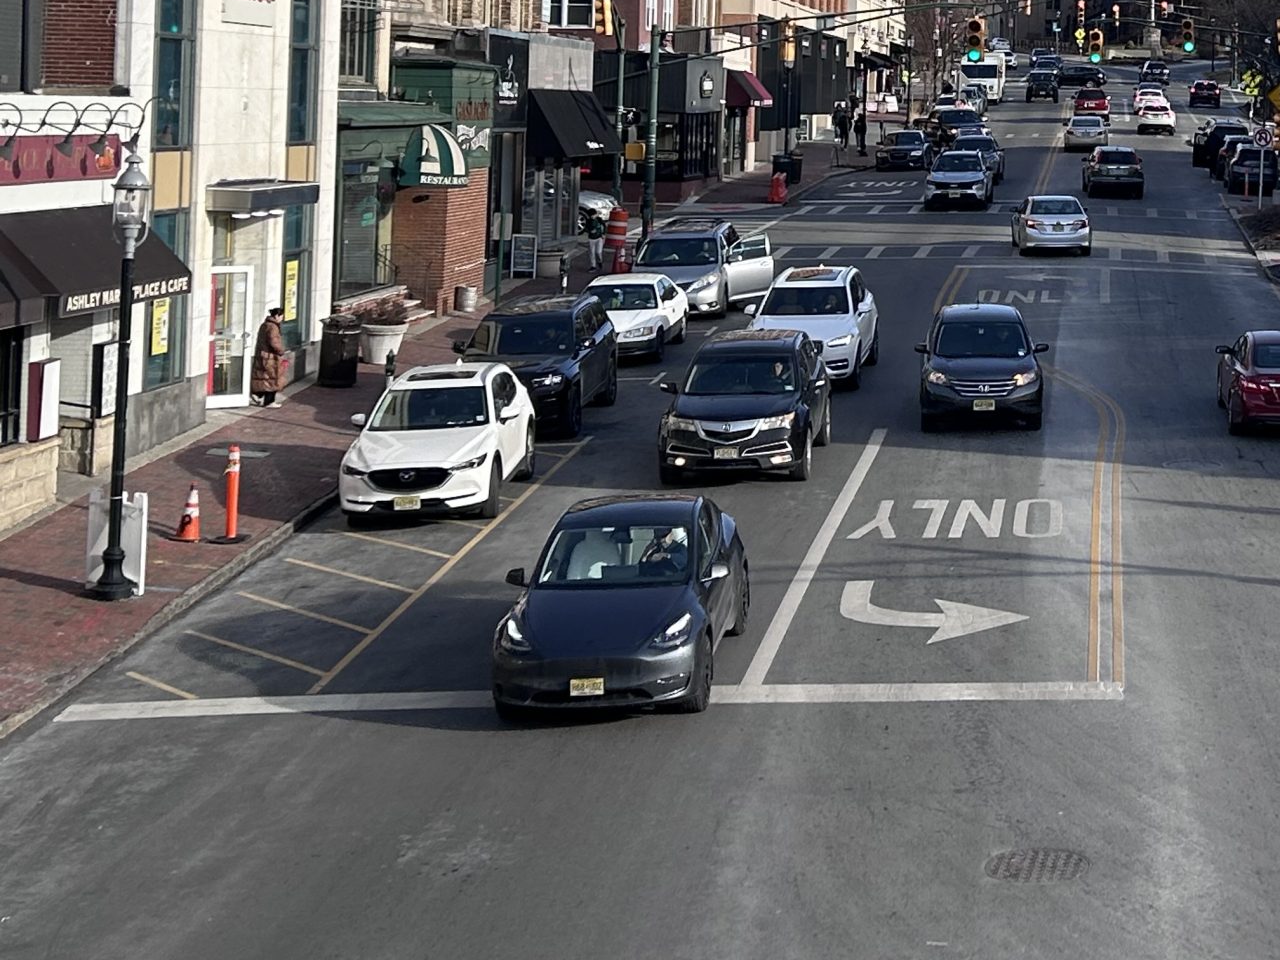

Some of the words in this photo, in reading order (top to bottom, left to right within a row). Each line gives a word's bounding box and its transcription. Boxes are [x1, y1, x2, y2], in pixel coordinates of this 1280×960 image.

[66, 292, 101, 312] ASHLEY
[160, 281, 167, 294] &
[167, 277, 188, 293] CAFE
[846, 499, 1063, 539] ONLY
